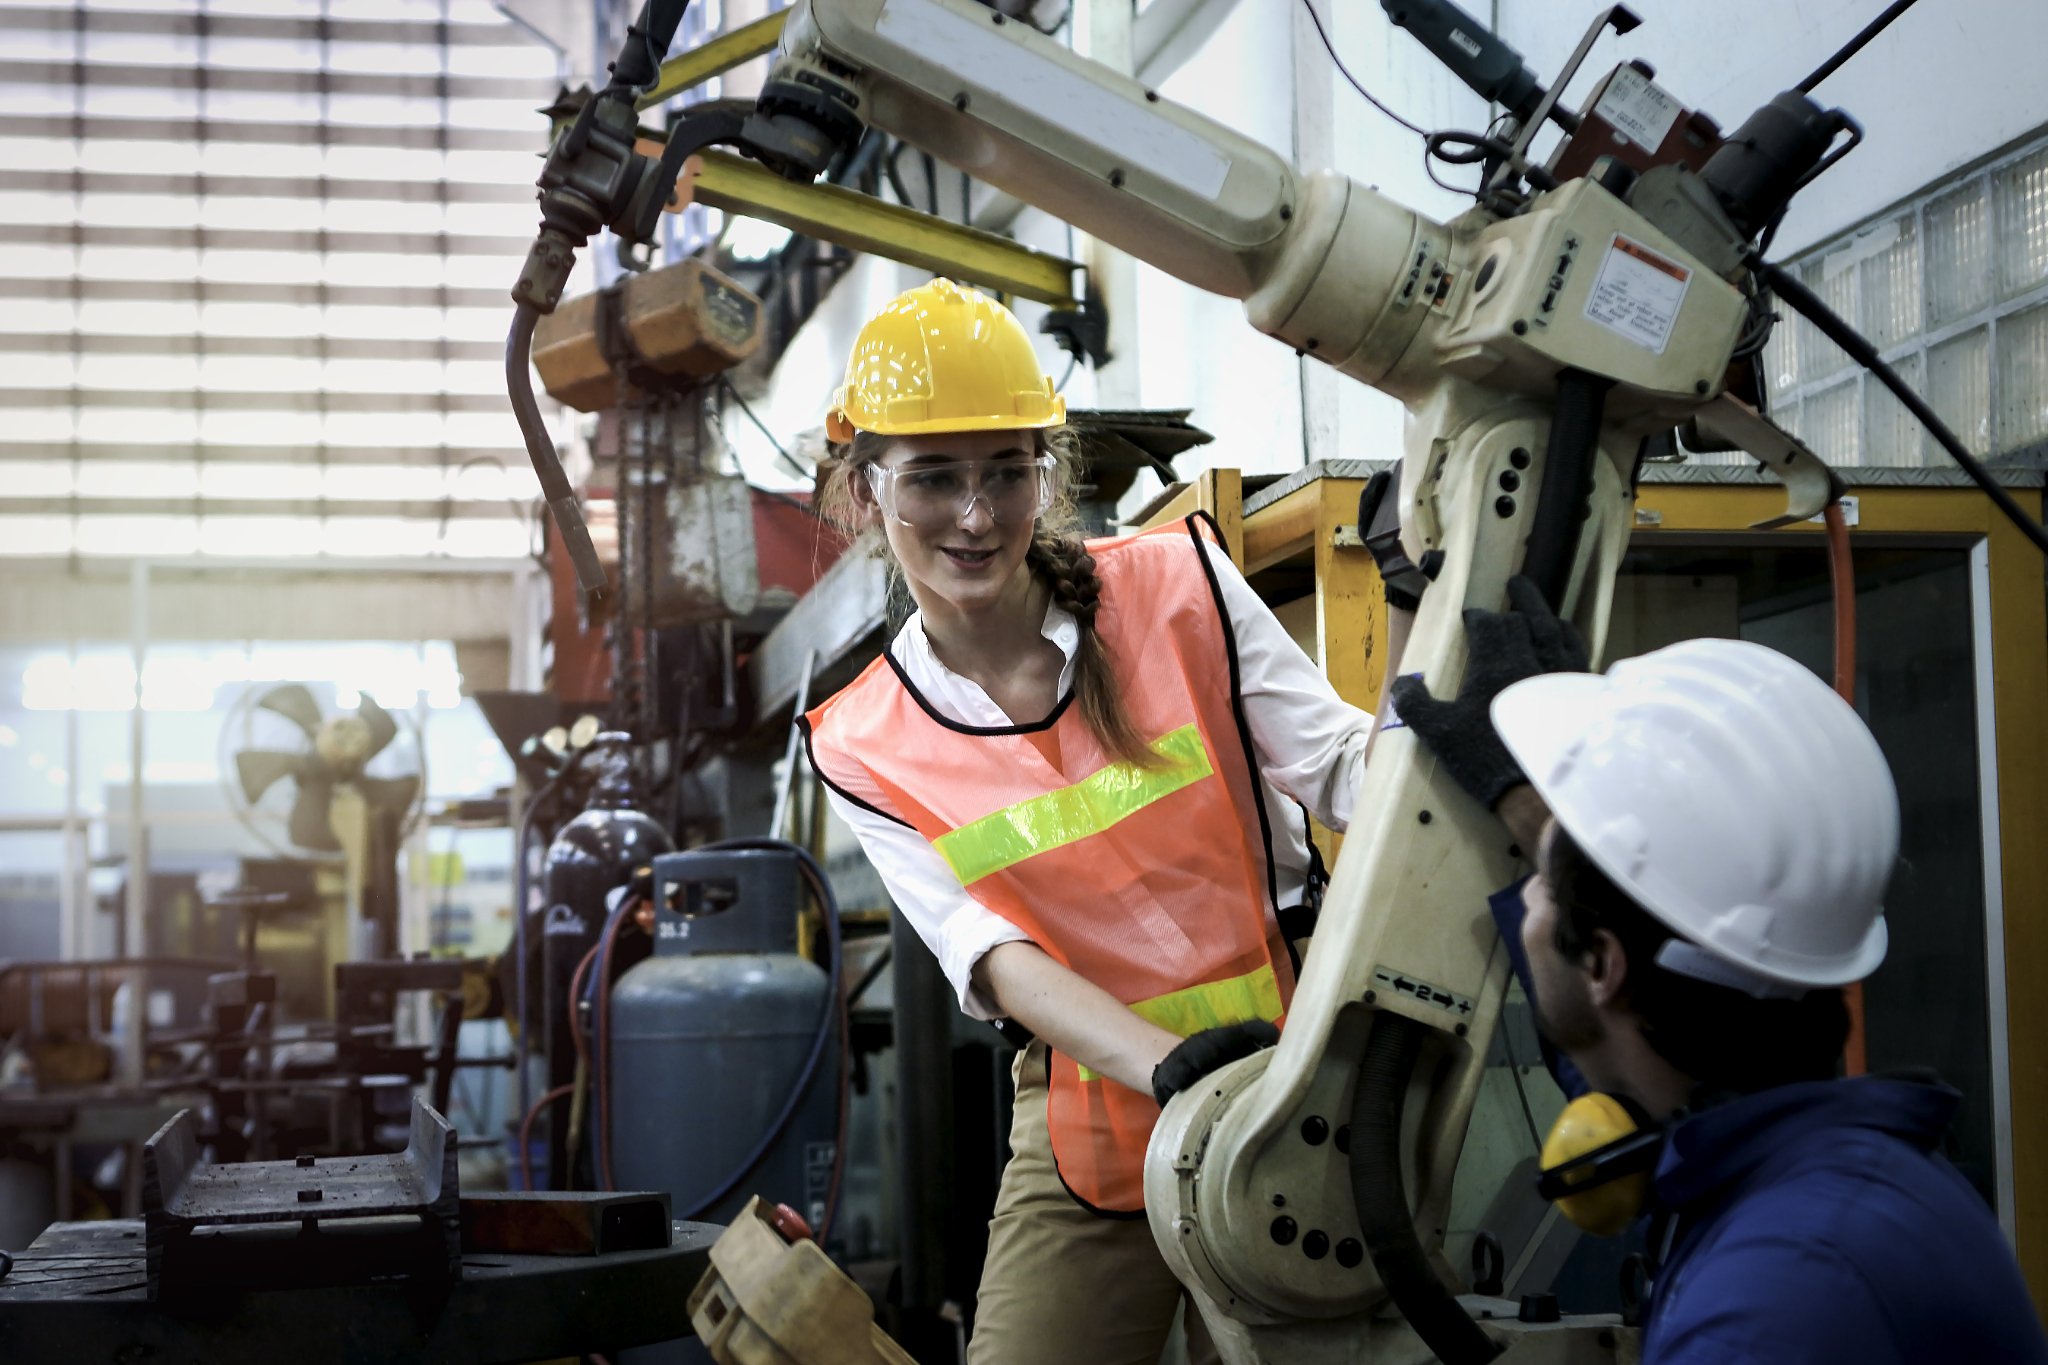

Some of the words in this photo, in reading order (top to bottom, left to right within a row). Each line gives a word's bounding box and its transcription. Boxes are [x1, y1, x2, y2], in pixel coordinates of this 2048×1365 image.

[1616, 294, 1627, 303] out
[1591, 307, 1615, 322] Manual
[1630, 318, 1662, 338] Instruction
[1415, 984, 1432, 1001] 2
